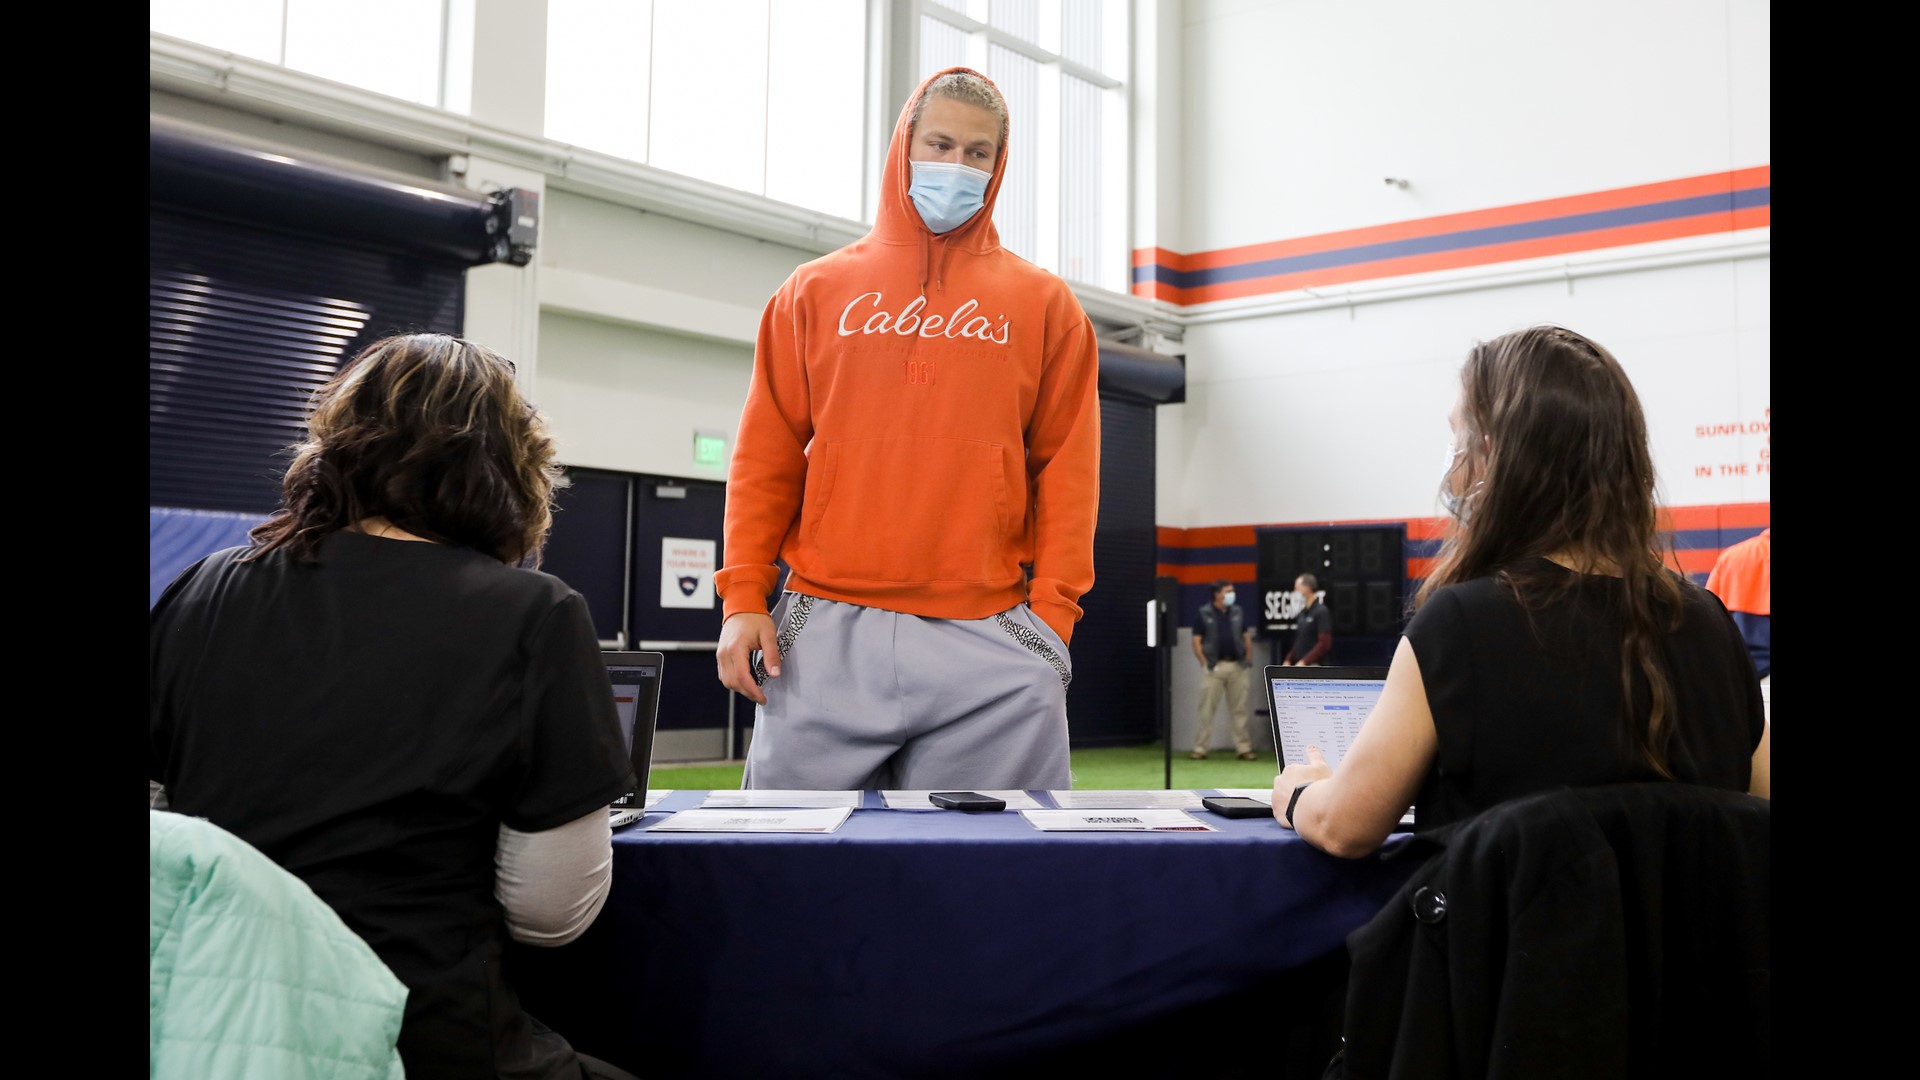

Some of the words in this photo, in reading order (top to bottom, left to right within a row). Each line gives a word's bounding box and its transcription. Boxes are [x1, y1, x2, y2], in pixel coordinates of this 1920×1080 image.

[837, 291, 1010, 345] Cabela's
[902, 361, 938, 386] 1961
[1695, 465, 1712, 477] IN
[1720, 463, 1748, 477] THE
[666, 559, 687, 569] YOUR
